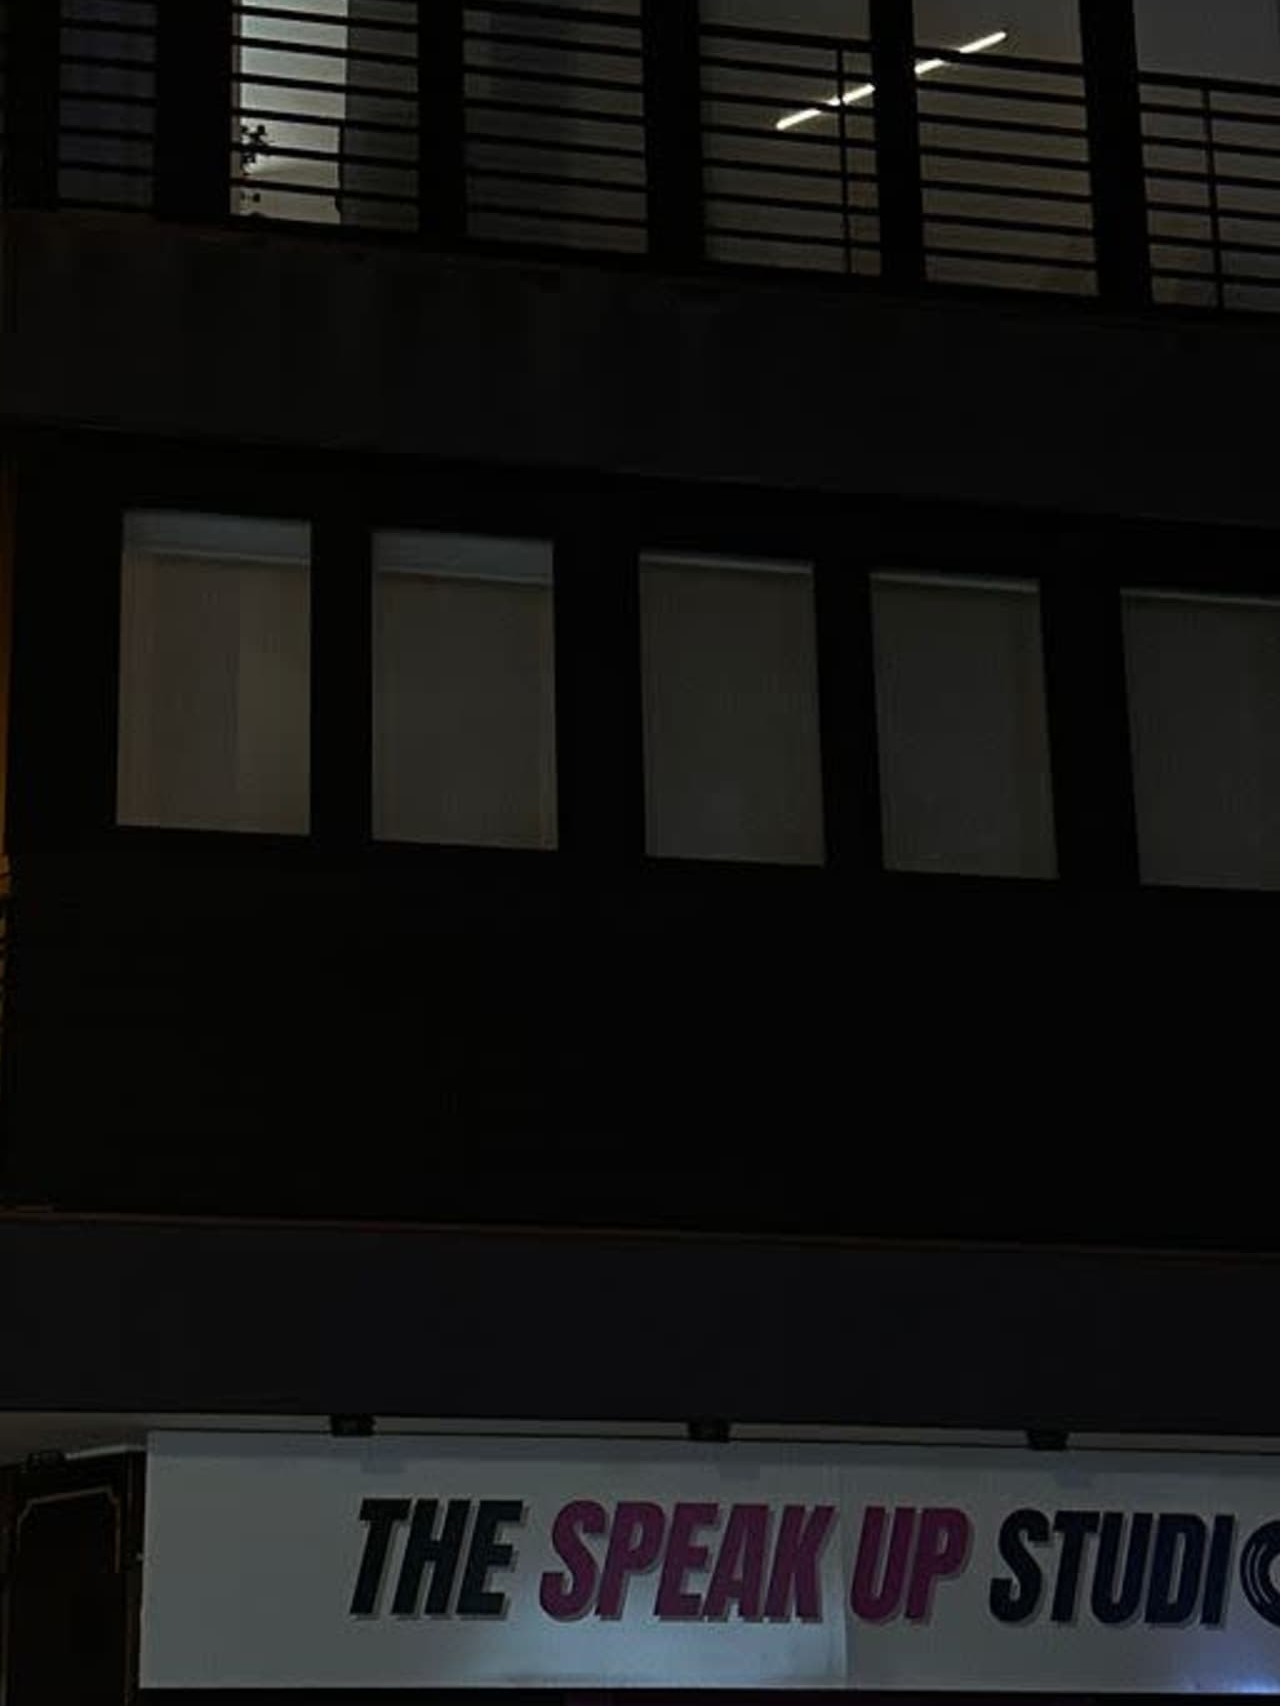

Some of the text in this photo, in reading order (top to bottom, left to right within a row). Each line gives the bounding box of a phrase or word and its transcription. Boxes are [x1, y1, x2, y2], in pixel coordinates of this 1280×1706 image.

[350, 1497, 524, 1621] THE
[539, 1499, 837, 1625] SPEAK
[850, 1505, 972, 1625] UP
